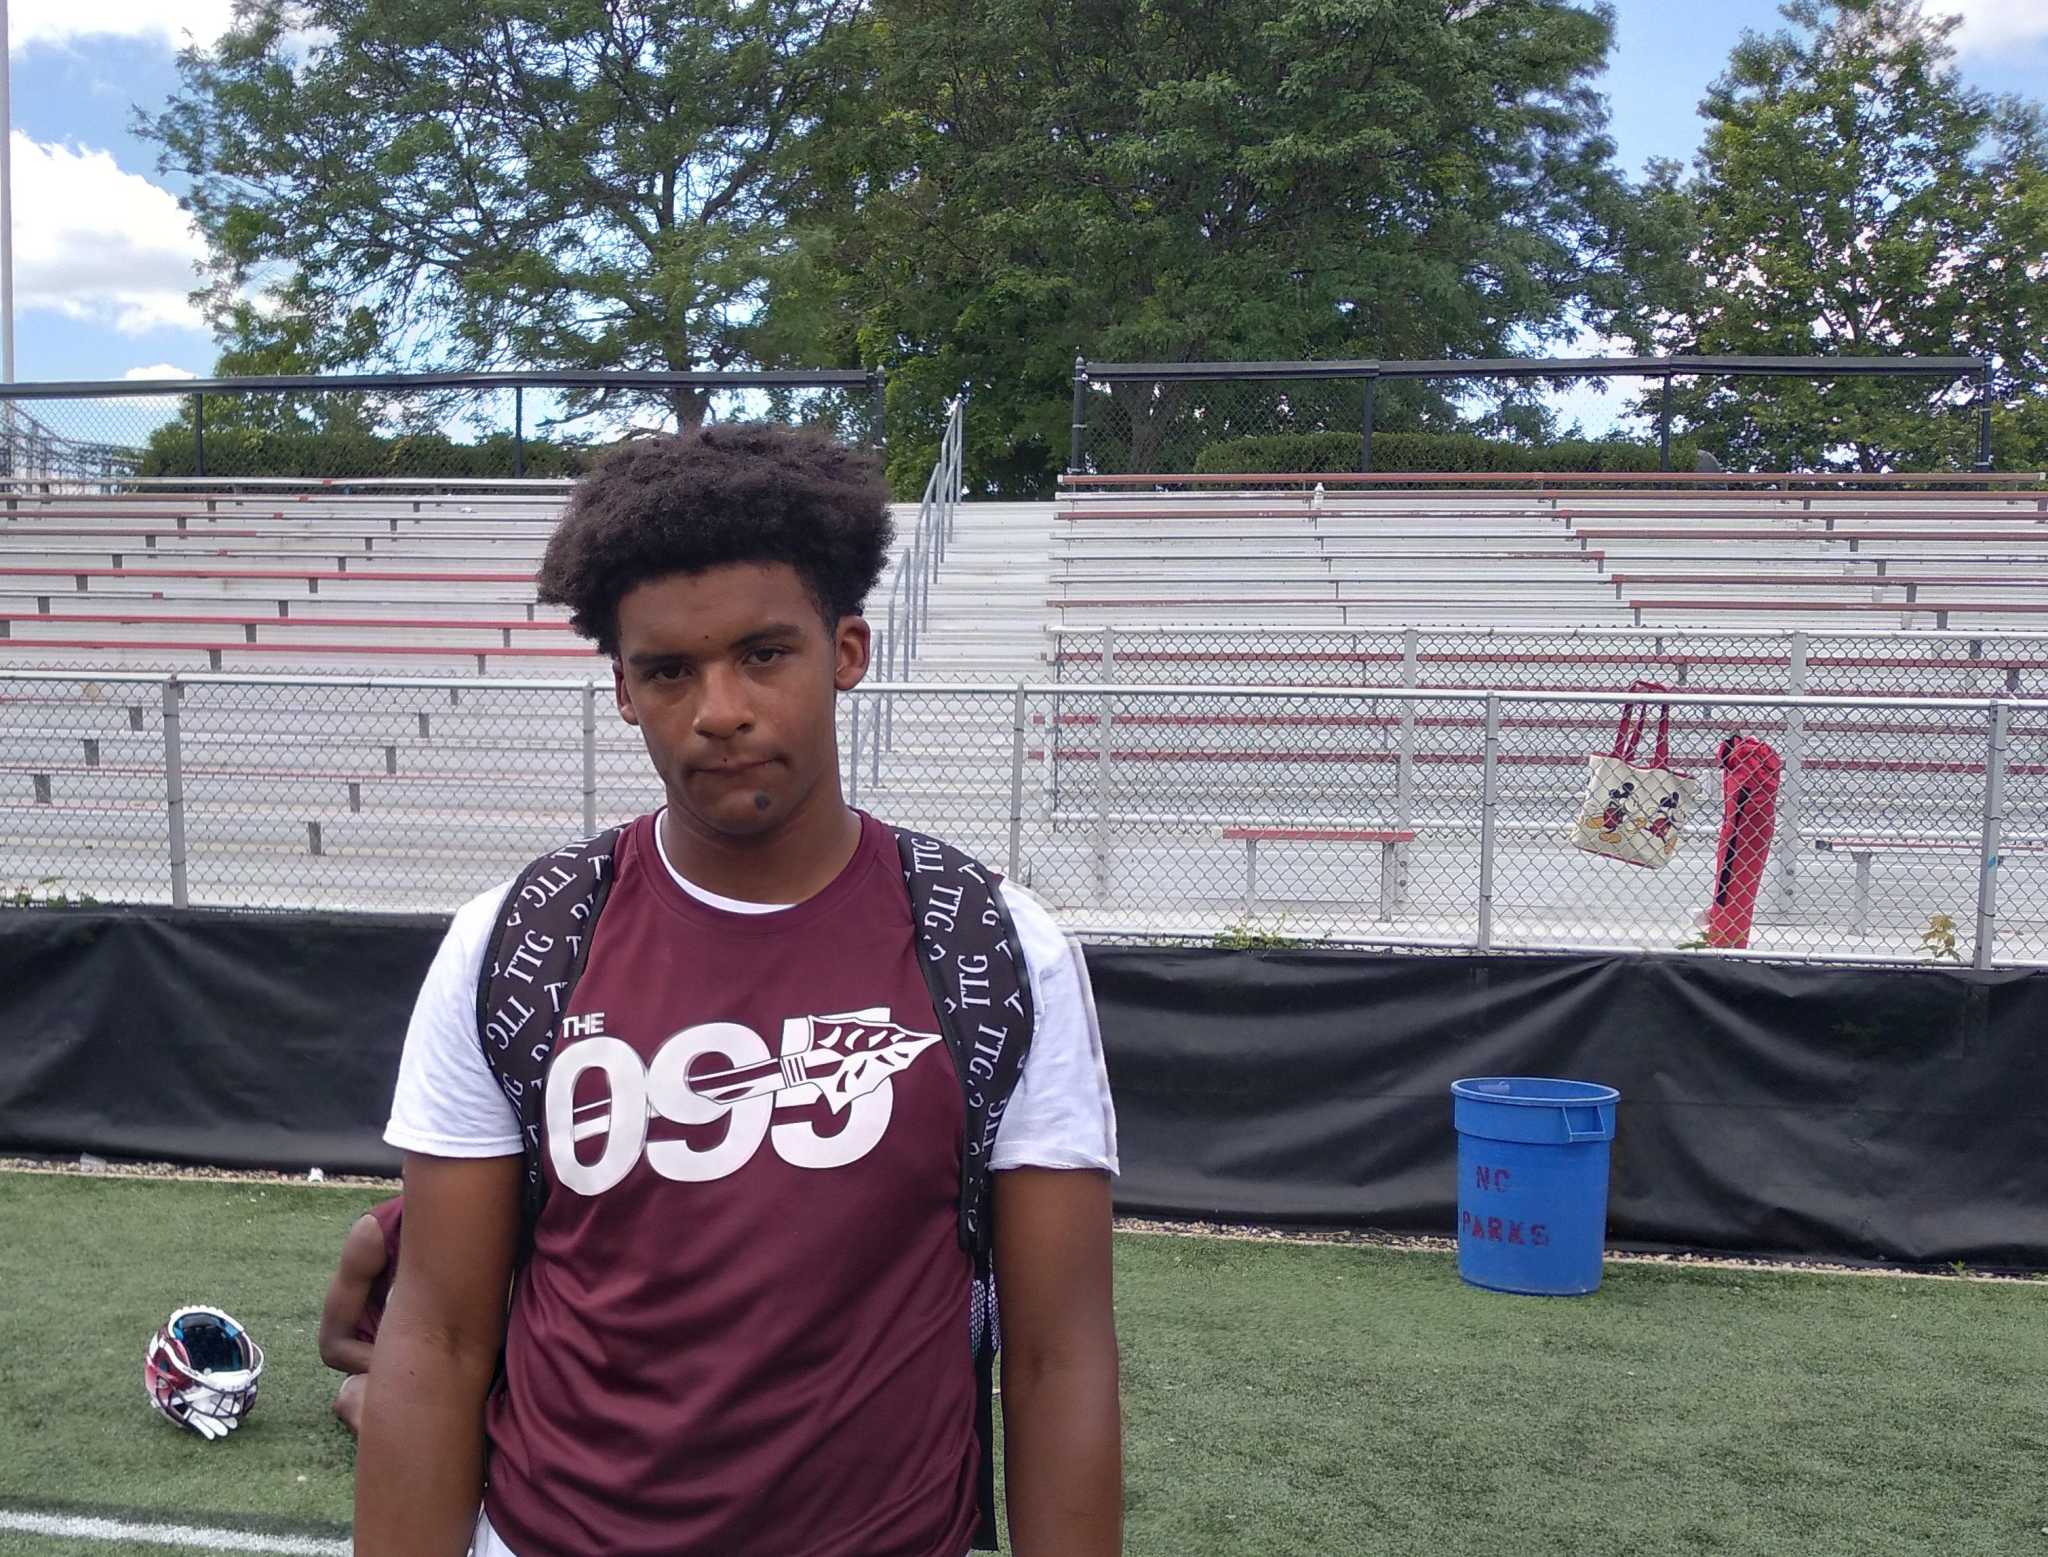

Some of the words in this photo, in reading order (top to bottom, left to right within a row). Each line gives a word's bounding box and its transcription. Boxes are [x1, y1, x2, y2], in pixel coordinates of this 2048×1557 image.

[550, 833, 602, 859] TT
[910, 837, 945, 874] TTG
[520, 865, 578, 909] TTG
[924, 883, 964, 933] TTG
[503, 929, 554, 984] TTG
[957, 954, 991, 1010] TTG
[485, 995, 535, 1051] TTG
[562, 1011, 605, 1038] THE
[967, 1023, 1009, 1081] TTG
[545, 1006, 895, 1197] 095
[1475, 1164, 1512, 1193] NC
[1461, 1209, 1552, 1247] PARKS
